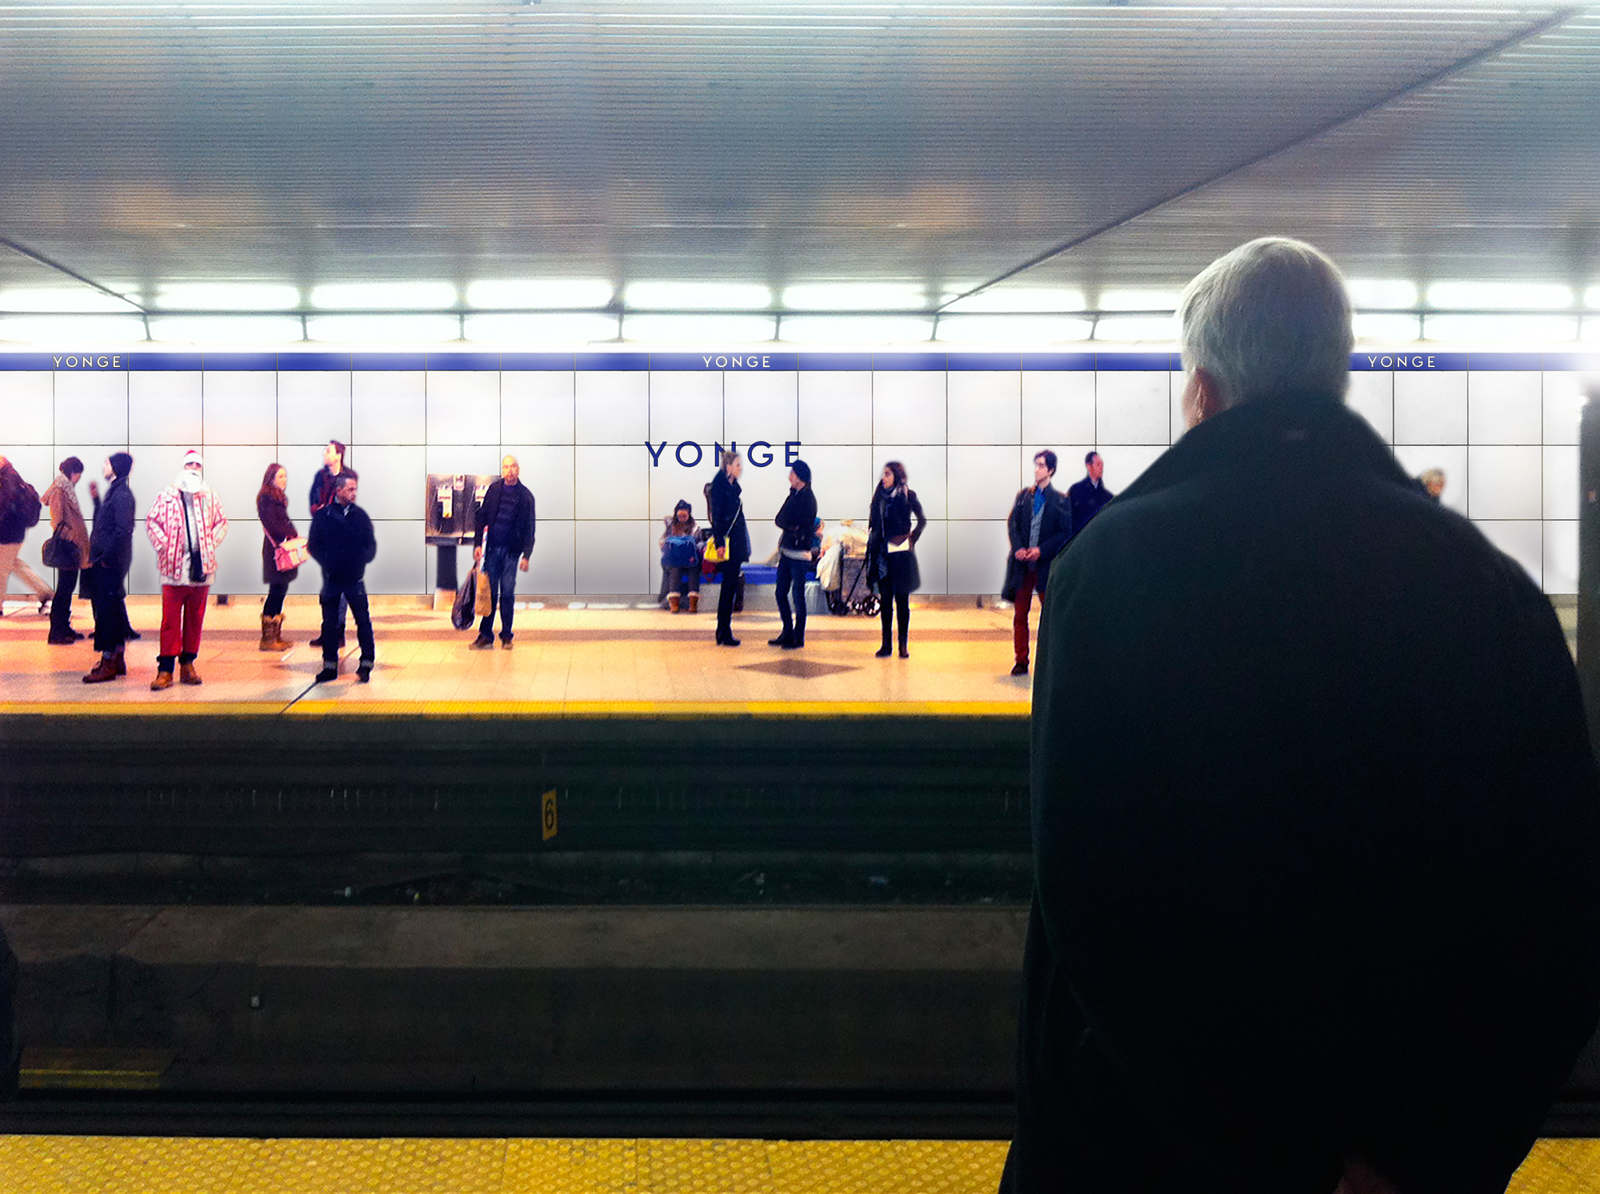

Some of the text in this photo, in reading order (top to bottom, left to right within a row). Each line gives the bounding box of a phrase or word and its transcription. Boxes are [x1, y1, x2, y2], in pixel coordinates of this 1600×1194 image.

[53, 355, 121, 368] YONGE
[702, 355, 771, 368] YONGE
[1367, 355, 1436, 368] YONGE
[544, 799, 554, 830] 6
